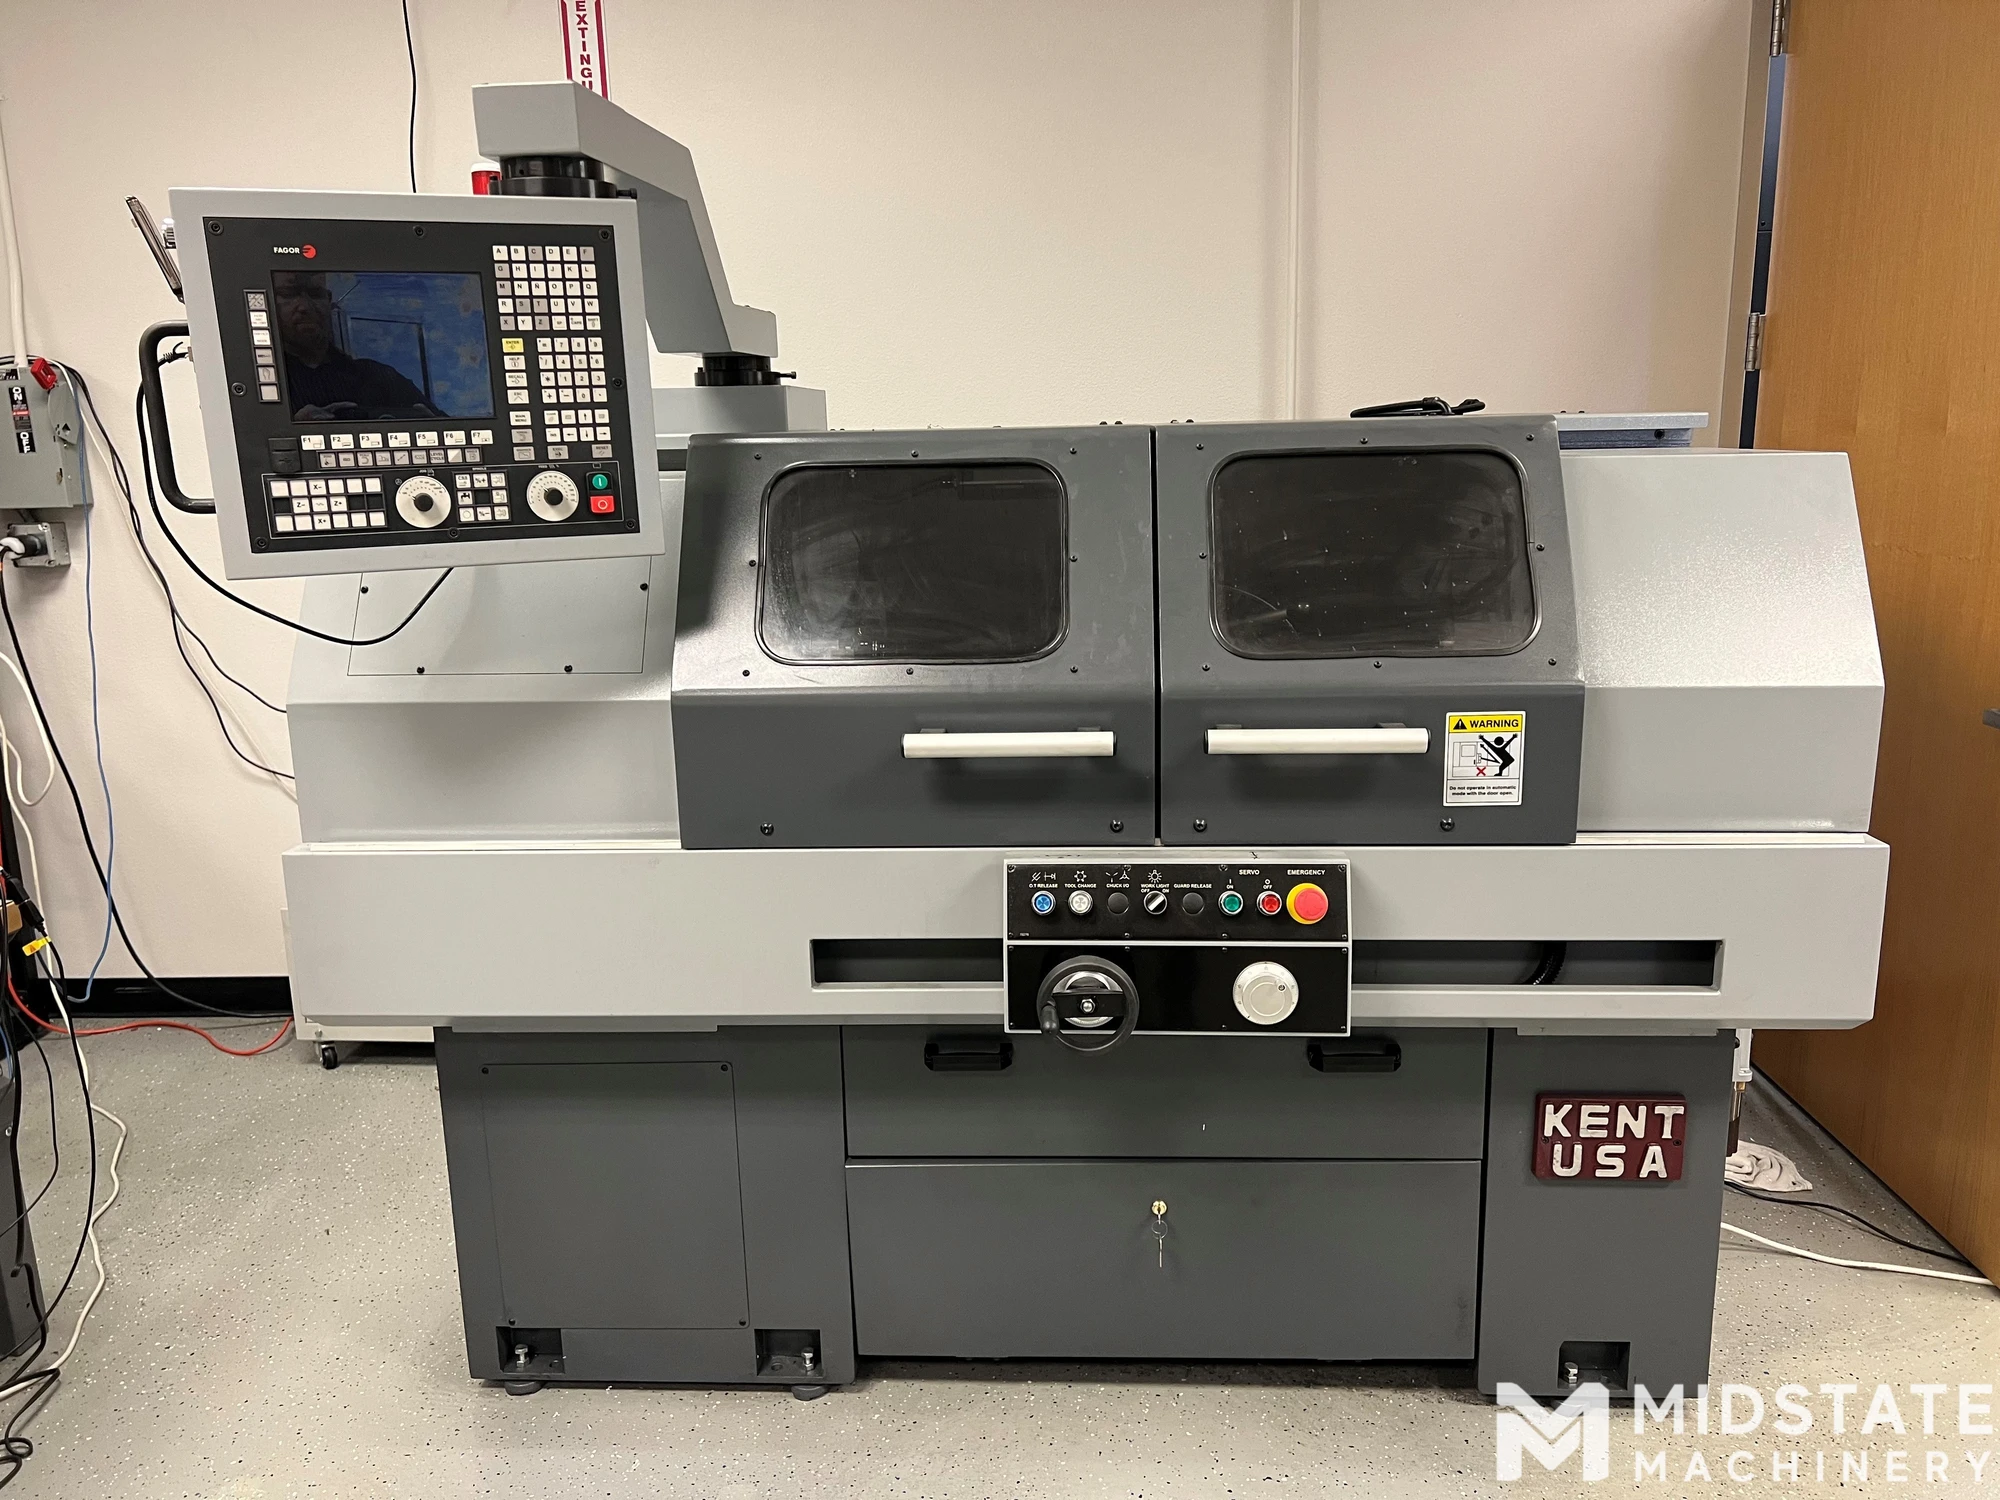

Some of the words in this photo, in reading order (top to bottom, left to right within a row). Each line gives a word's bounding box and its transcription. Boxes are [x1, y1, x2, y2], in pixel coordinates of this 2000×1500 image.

[273, 246, 300, 254] FAGOR
[12, 387, 23, 401] ON
[20, 431, 31, 454] OFF
[1469, 719, 1519, 728] WARNING
[1543, 1104, 1685, 1139] KENT
[1552, 1144, 1667, 1178] USA
